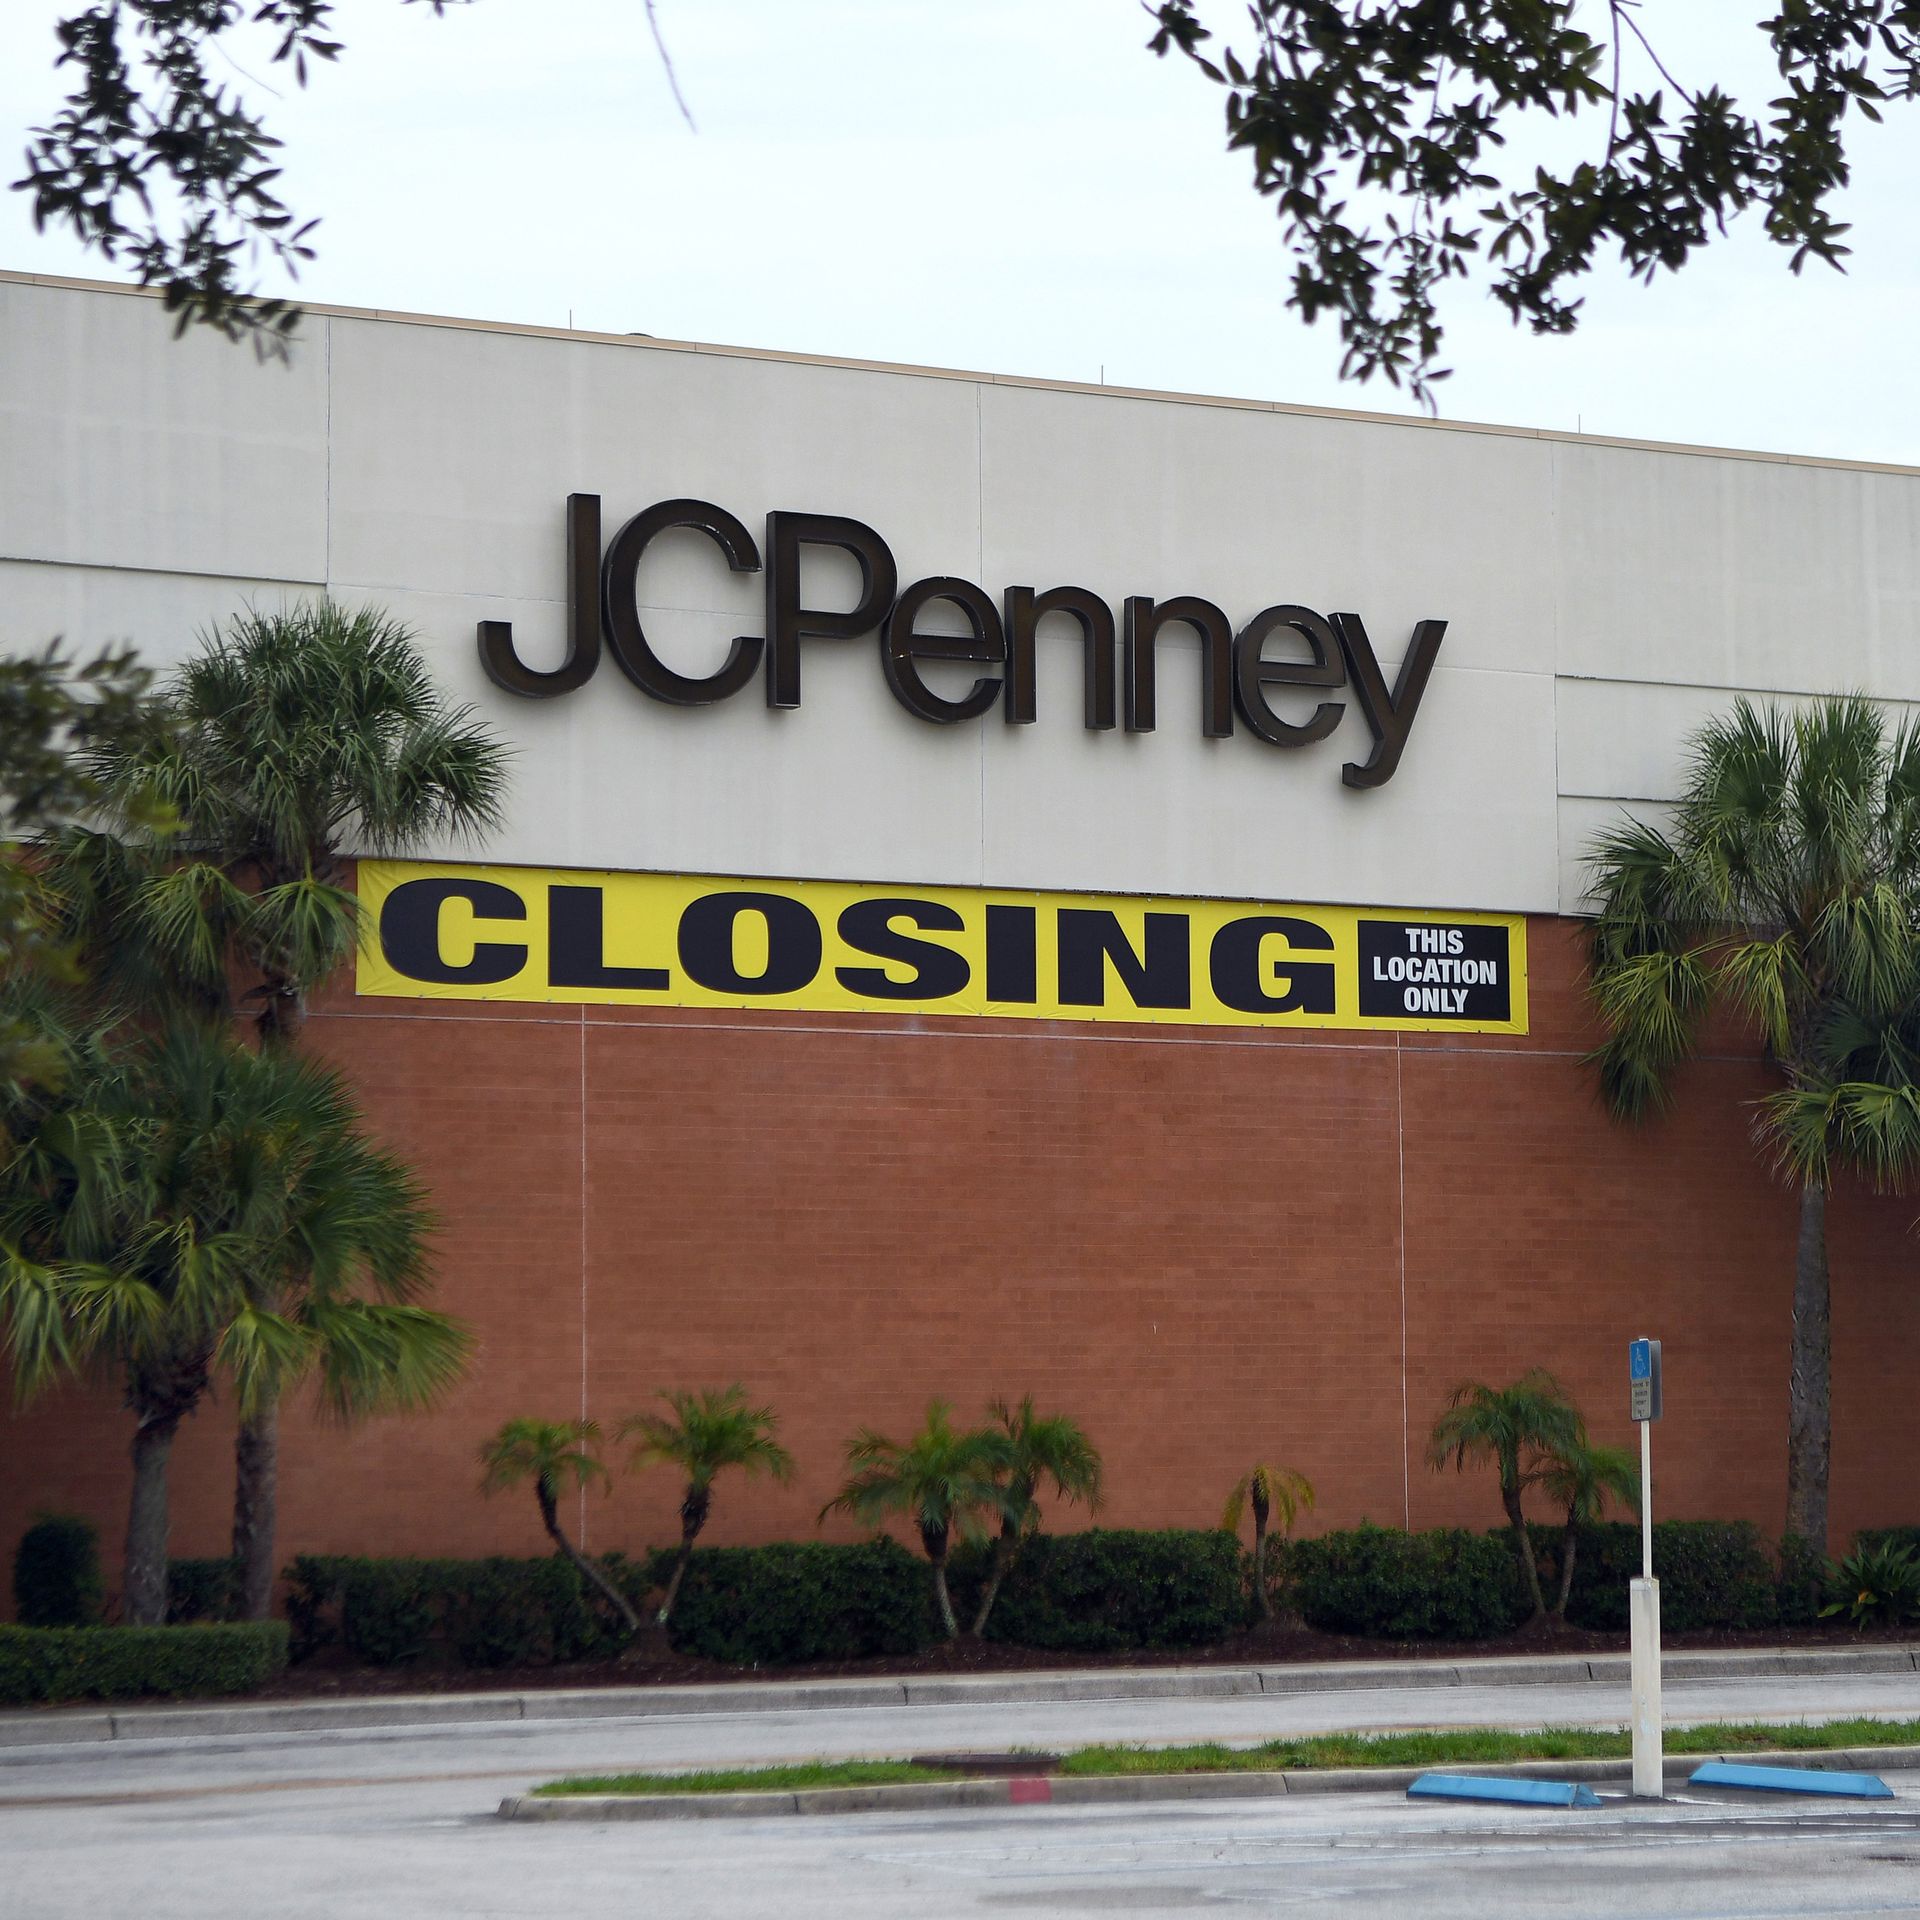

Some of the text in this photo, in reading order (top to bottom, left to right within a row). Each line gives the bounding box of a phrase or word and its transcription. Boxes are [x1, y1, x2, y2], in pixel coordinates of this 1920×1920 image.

[477, 493, 1448, 790] JCPenney
[379, 878, 1336, 1015] CLOSING
[1405, 928, 1464, 955] THIS
[1373, 956, 1497, 985] LOCATION
[1403, 986, 1469, 1013] ONLY
